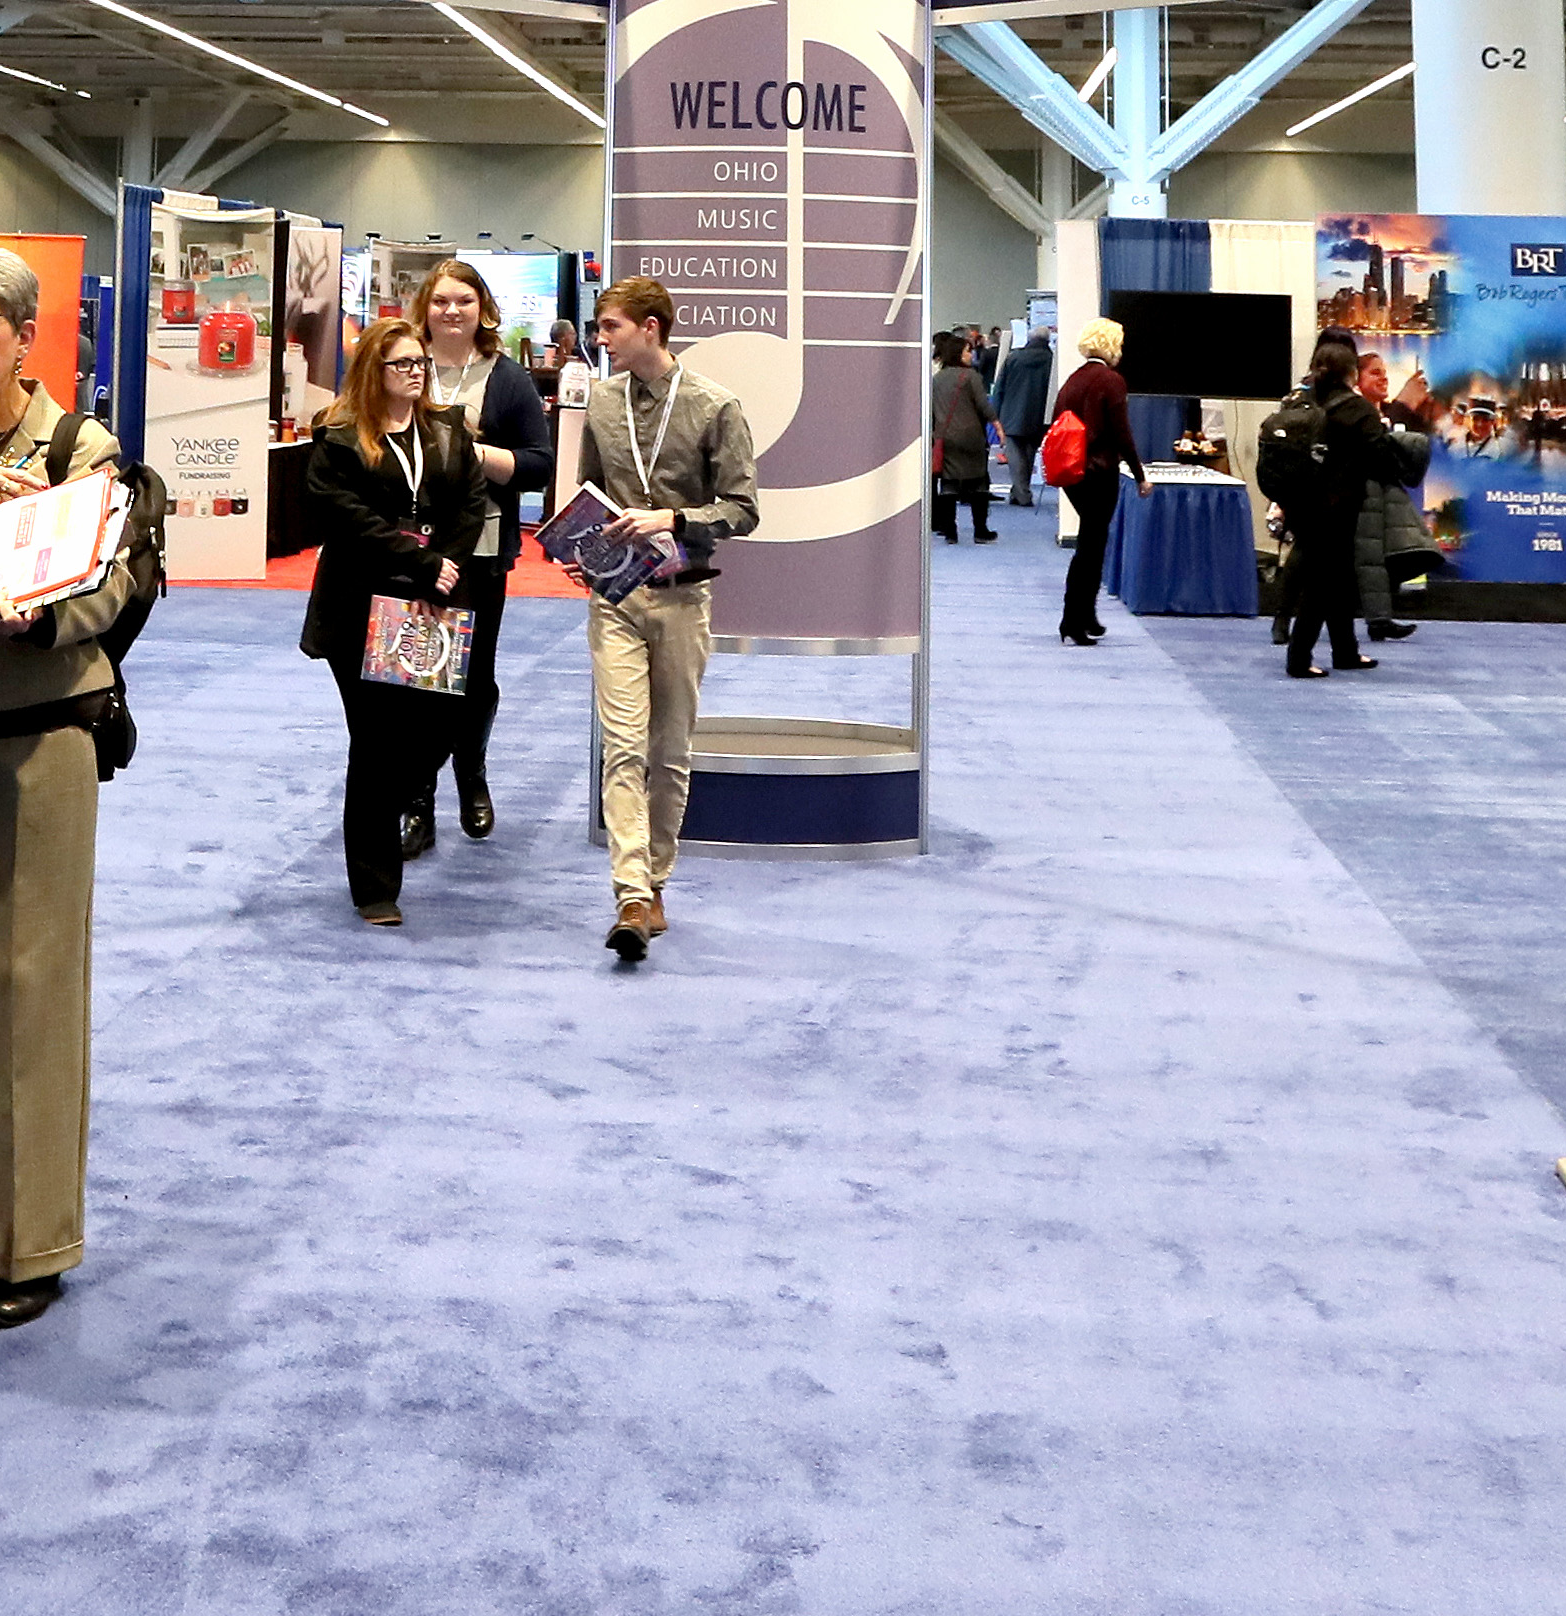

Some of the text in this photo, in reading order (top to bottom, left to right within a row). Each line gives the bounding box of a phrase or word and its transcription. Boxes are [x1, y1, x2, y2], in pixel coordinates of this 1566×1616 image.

[1482, 47, 1527, 69] C-2
[670, 81, 867, 133] WELCOME
[713, 161, 778, 182] OHIO
[1132, 196, 1150, 205] C-5
[697, 209, 778, 230] MUSIC
[640, 256, 777, 279] EDUCATION
[1516, 248, 1563, 273] BRT
[676, 305, 777, 327] CIATION
[1486, 491, 1540, 504] Making
[1506, 504, 1538, 515] That
[1532, 539, 1563, 551] 1981
